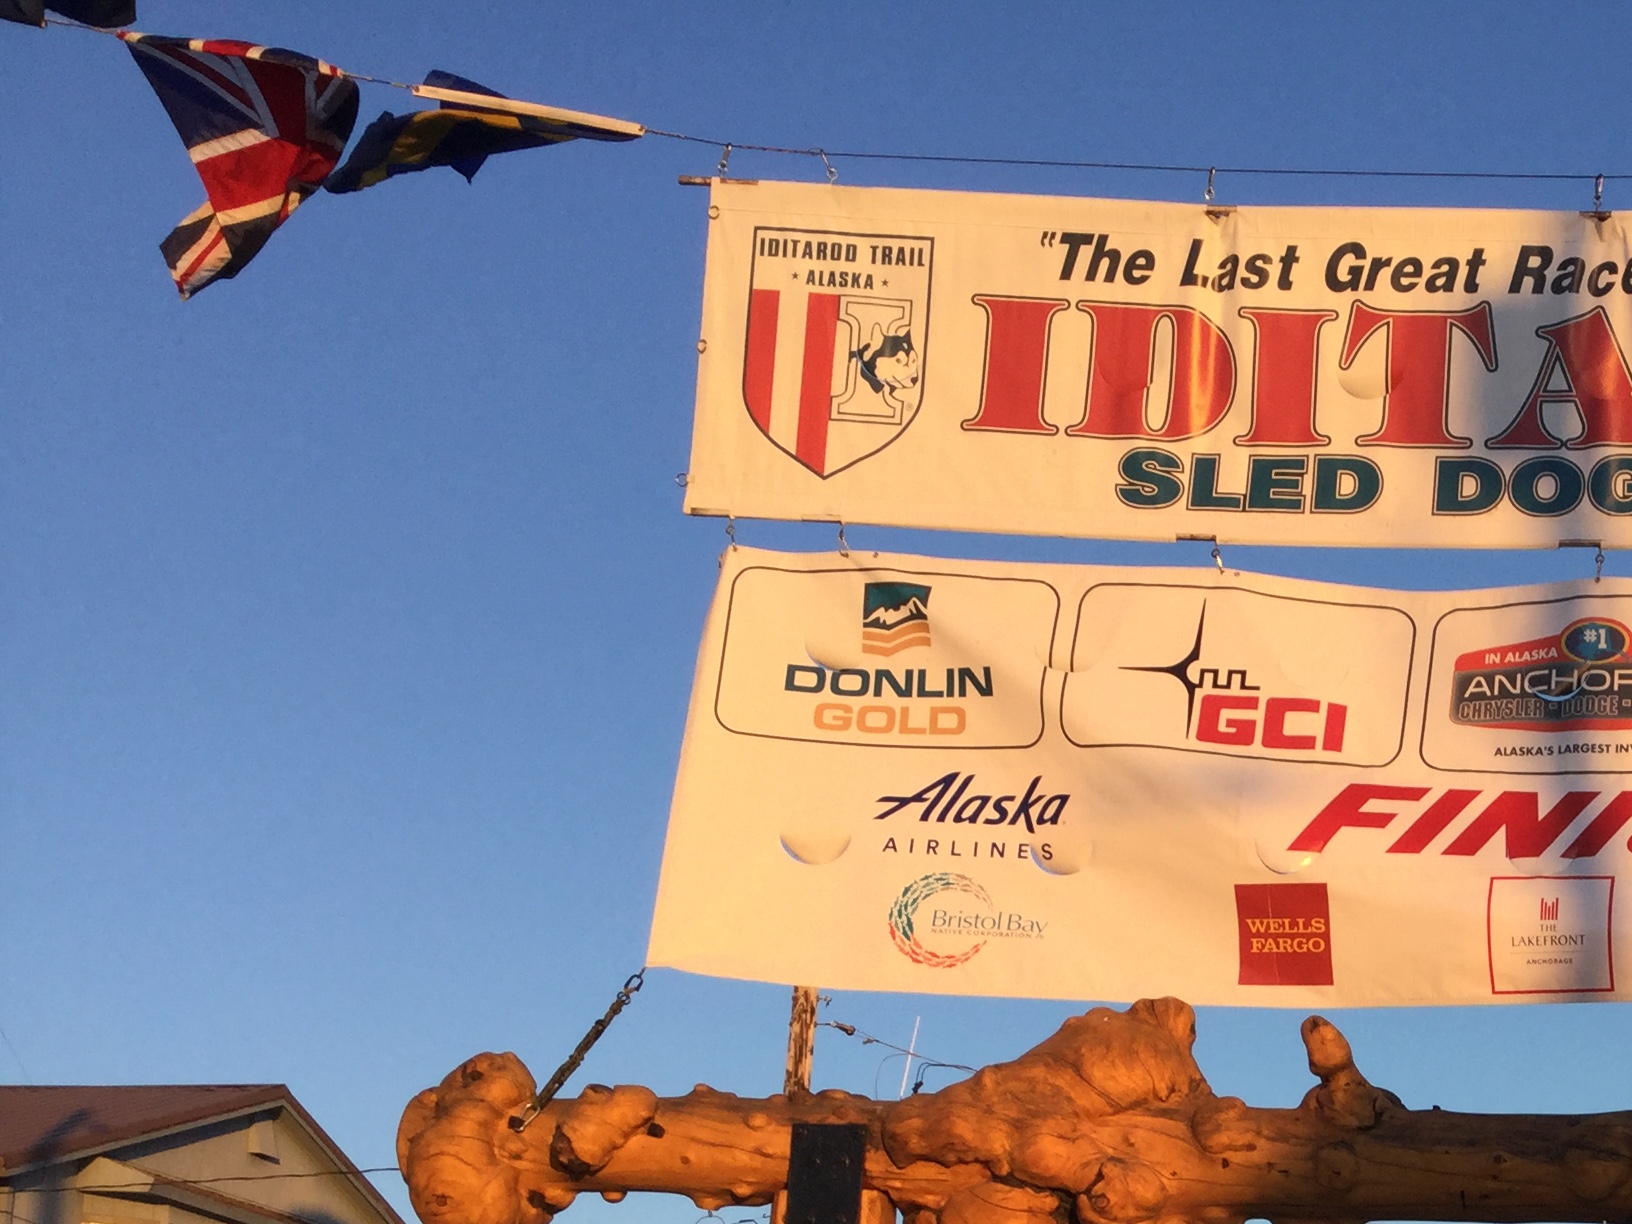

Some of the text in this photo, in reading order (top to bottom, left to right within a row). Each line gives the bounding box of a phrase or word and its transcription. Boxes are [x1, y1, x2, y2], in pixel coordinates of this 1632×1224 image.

[759, 237, 926, 268] IDITAROD TRAIL
[1181, 239, 1300, 292] Last
[1325, 241, 1487, 293] Great
[806, 269, 875, 290] ALASKA
[1115, 447, 1384, 515] SLED
[1583, 628, 1608, 650] #1
[1484, 647, 1558, 665] IN ALASKA
[784, 664, 994, 698] DONLIN
[813, 702, 967, 736] GOLD
[1458, 698, 1544, 720] CHRYSLER
[1561, 695, 1619, 718] DODGE
[1195, 692, 1348, 753] GCI
[1494, 745, 1555, 757] ALASKA'S
[1558, 743, 1611, 756] LARGEST
[874, 771, 1070, 834] Alaska
[882, 837, 1054, 861] AIRLINES
[931, 909, 1049, 938] Bristol Bay
[966, 929, 1032, 939] CORPORATION
[1246, 917, 1326, 935] WELLS
[1540, 924, 1557, 932] THE
[1250, 936, 1326, 954] FARGO
[1511, 934, 1585, 947] LAKEFRONT
[1526, 957, 1573, 965] ANCHORAGE
